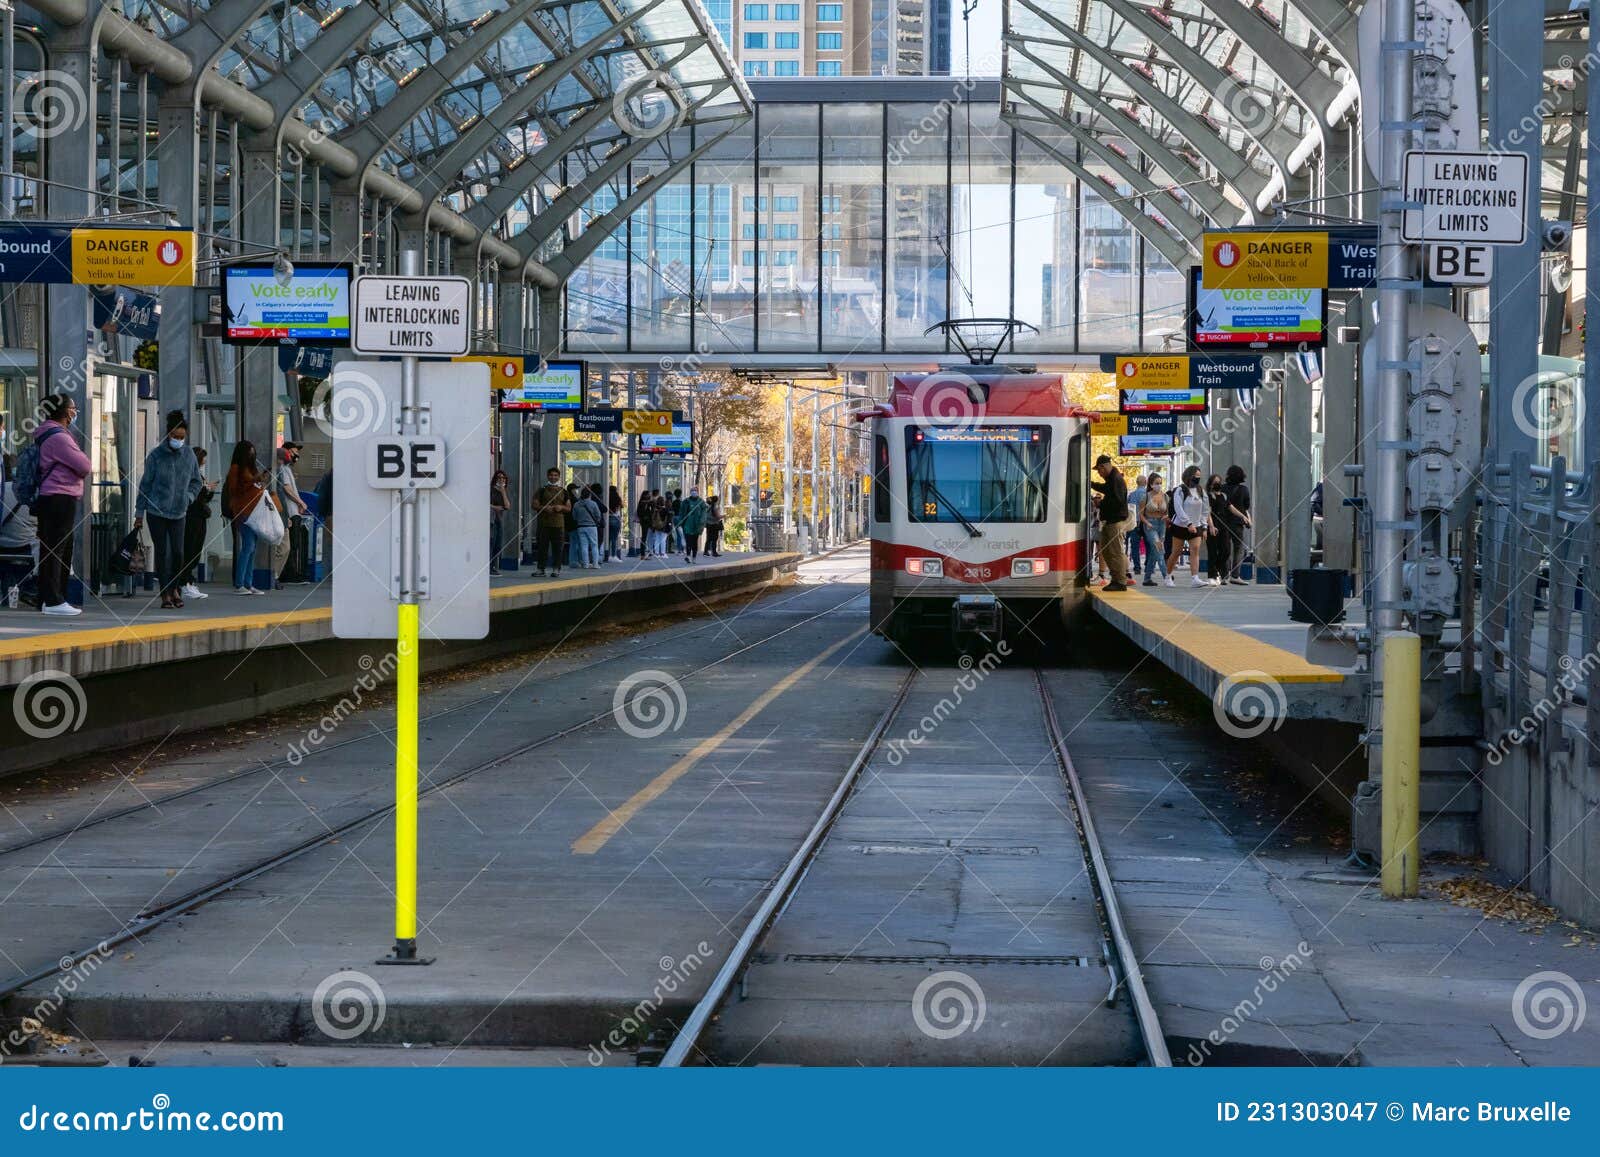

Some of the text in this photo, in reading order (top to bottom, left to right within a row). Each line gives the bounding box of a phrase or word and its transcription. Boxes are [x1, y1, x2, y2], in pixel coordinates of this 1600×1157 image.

[1434, 163, 1497, 181] LEAVING
[1413, 187, 1517, 207] INTERLOCKING
[1438, 214, 1488, 232] LIMITS
[86, 239, 149, 252] DANGER
[1247, 242, 1313, 254] DANGER
[86, 254, 145, 265] Stand Back of
[1247, 258, 1308, 268] Stand Back of
[1436, 246, 1486, 277] BE
[87, 269, 136, 280] Yellow Line
[1247, 273, 1297, 282] Yellow Line
[250, 282, 339, 301] Vote early
[386, 284, 440, 301] LEAVING
[1221, 287, 1312, 304] Vote early
[365, 306, 460, 325] INTERLOCKING
[389, 330, 433, 347] LIMITS
[1141, 362, 1180, 370] DANGER
[1197, 363, 1255, 372] Westbound
[1197, 375, 1222, 384] Train
[377, 444, 437, 478] BE
